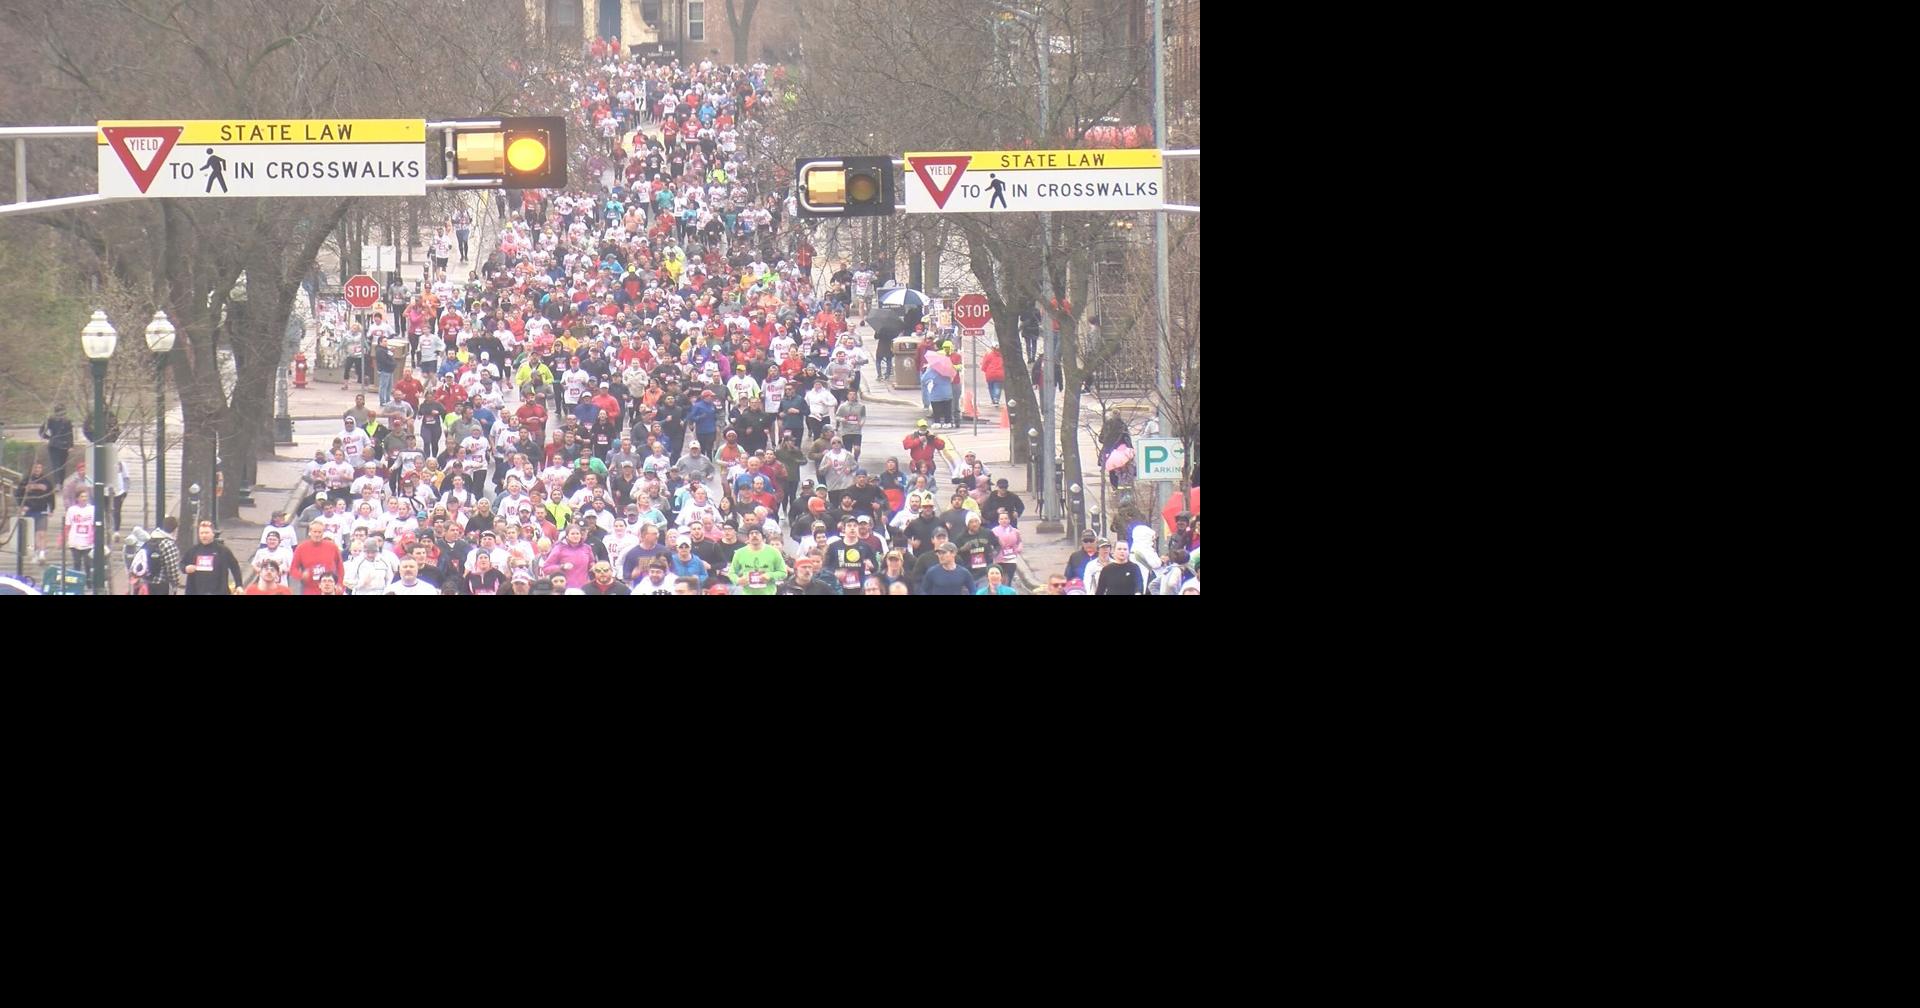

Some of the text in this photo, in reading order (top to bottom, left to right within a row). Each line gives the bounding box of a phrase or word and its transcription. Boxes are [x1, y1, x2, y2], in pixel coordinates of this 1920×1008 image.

[220, 123, 353, 141] STATE LAW
[129, 138, 159, 151] YIELD
[1001, 153, 1105, 168] STATE LAW
[169, 160, 420, 179] TO IN CROSSWALKS
[929, 165, 953, 176] YIELD
[961, 181, 1158, 198] TO IN CROSSWALKS
[346, 285, 378, 298] STOP
[957, 303, 990, 318] STOP
